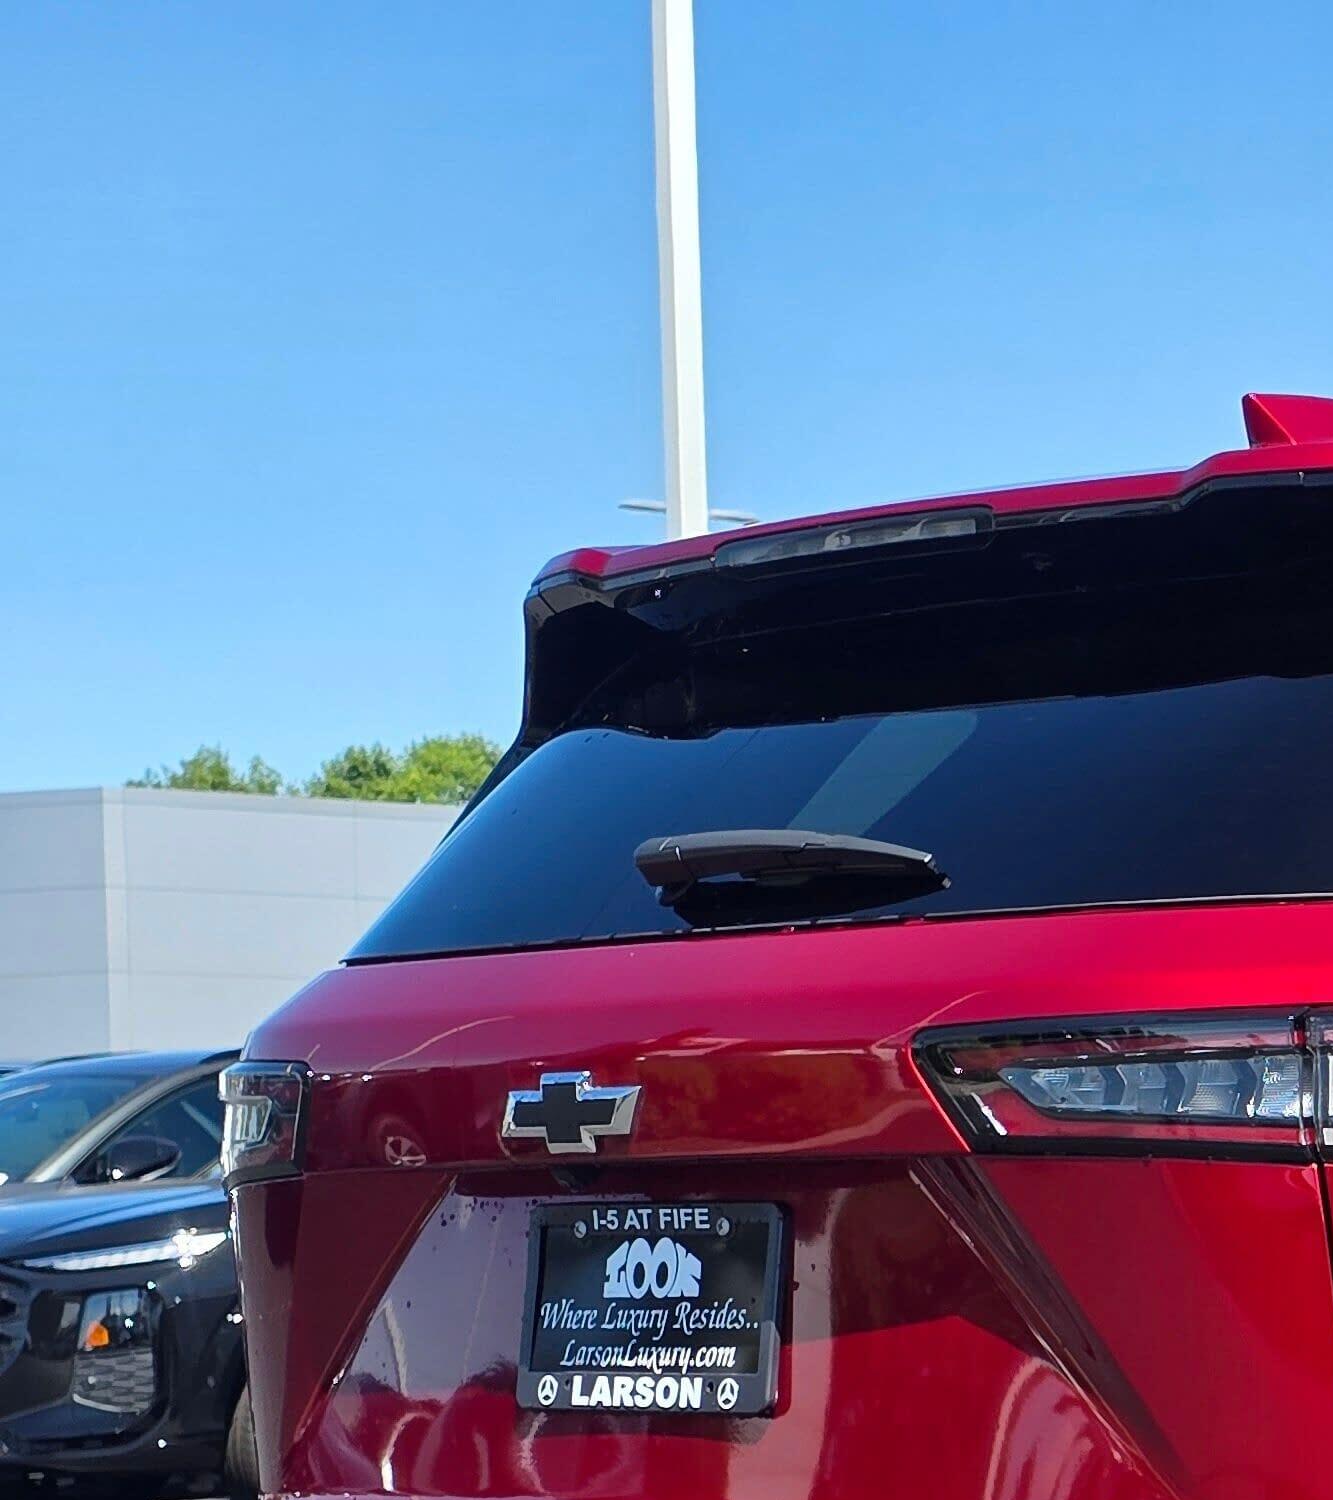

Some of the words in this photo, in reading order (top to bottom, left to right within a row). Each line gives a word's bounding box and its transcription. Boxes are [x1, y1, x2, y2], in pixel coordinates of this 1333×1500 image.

[592, 1209, 619, 1230] I-5
[624, 1209, 652, 1230] AT
[659, 1207, 710, 1230] FIFE
[603, 1236, 702, 1299] LOOK
[540, 1299, 598, 1330] Where
[601, 1302, 668, 1340] Luxury
[560, 1340, 737, 1374] LarsonLuxury.com
[571, 1375, 703, 1409] LARSON
